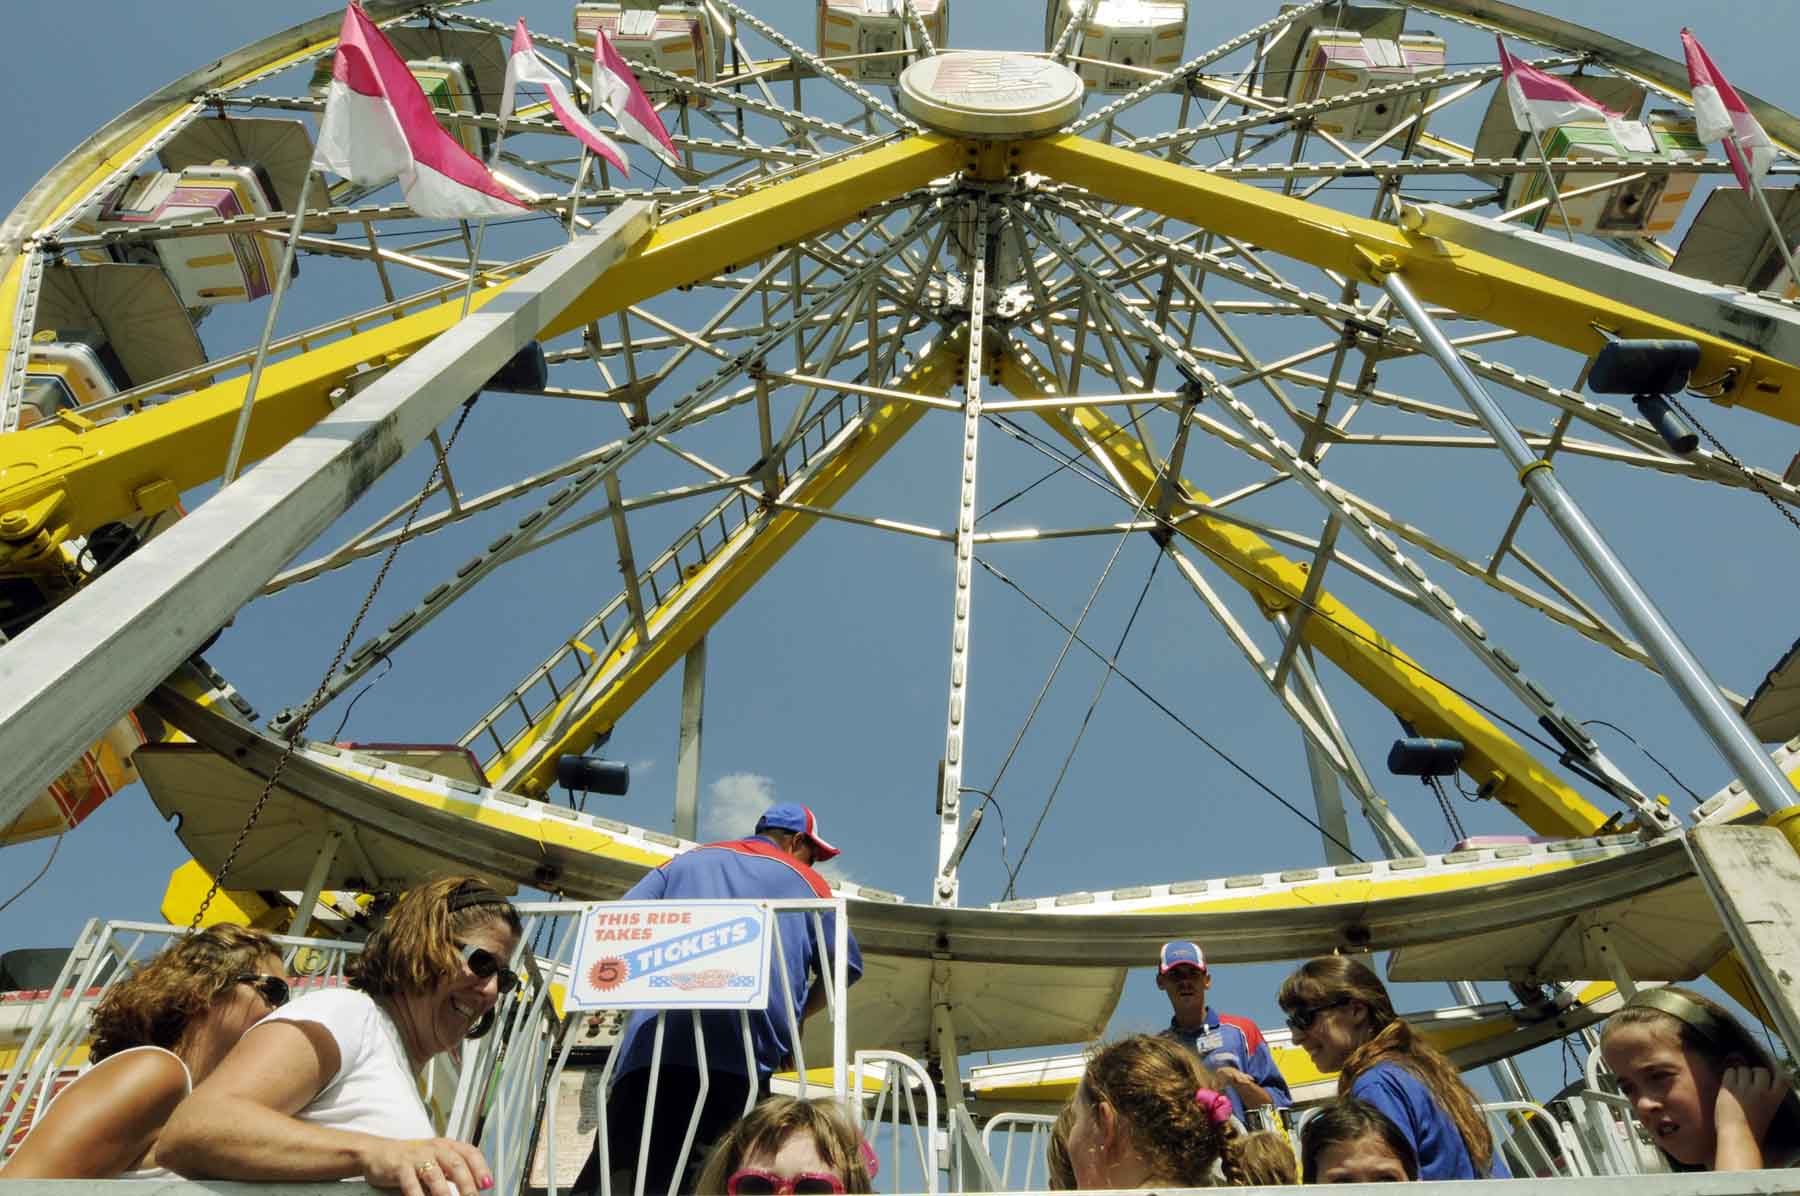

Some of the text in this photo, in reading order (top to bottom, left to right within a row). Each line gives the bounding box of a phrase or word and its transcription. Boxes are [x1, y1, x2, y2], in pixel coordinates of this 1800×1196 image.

[598, 912, 692, 926] THIS RIDE
[595, 927, 653, 941] TAKES
[637, 921, 748, 971] TICKETS
[598, 961, 619, 982] 5
